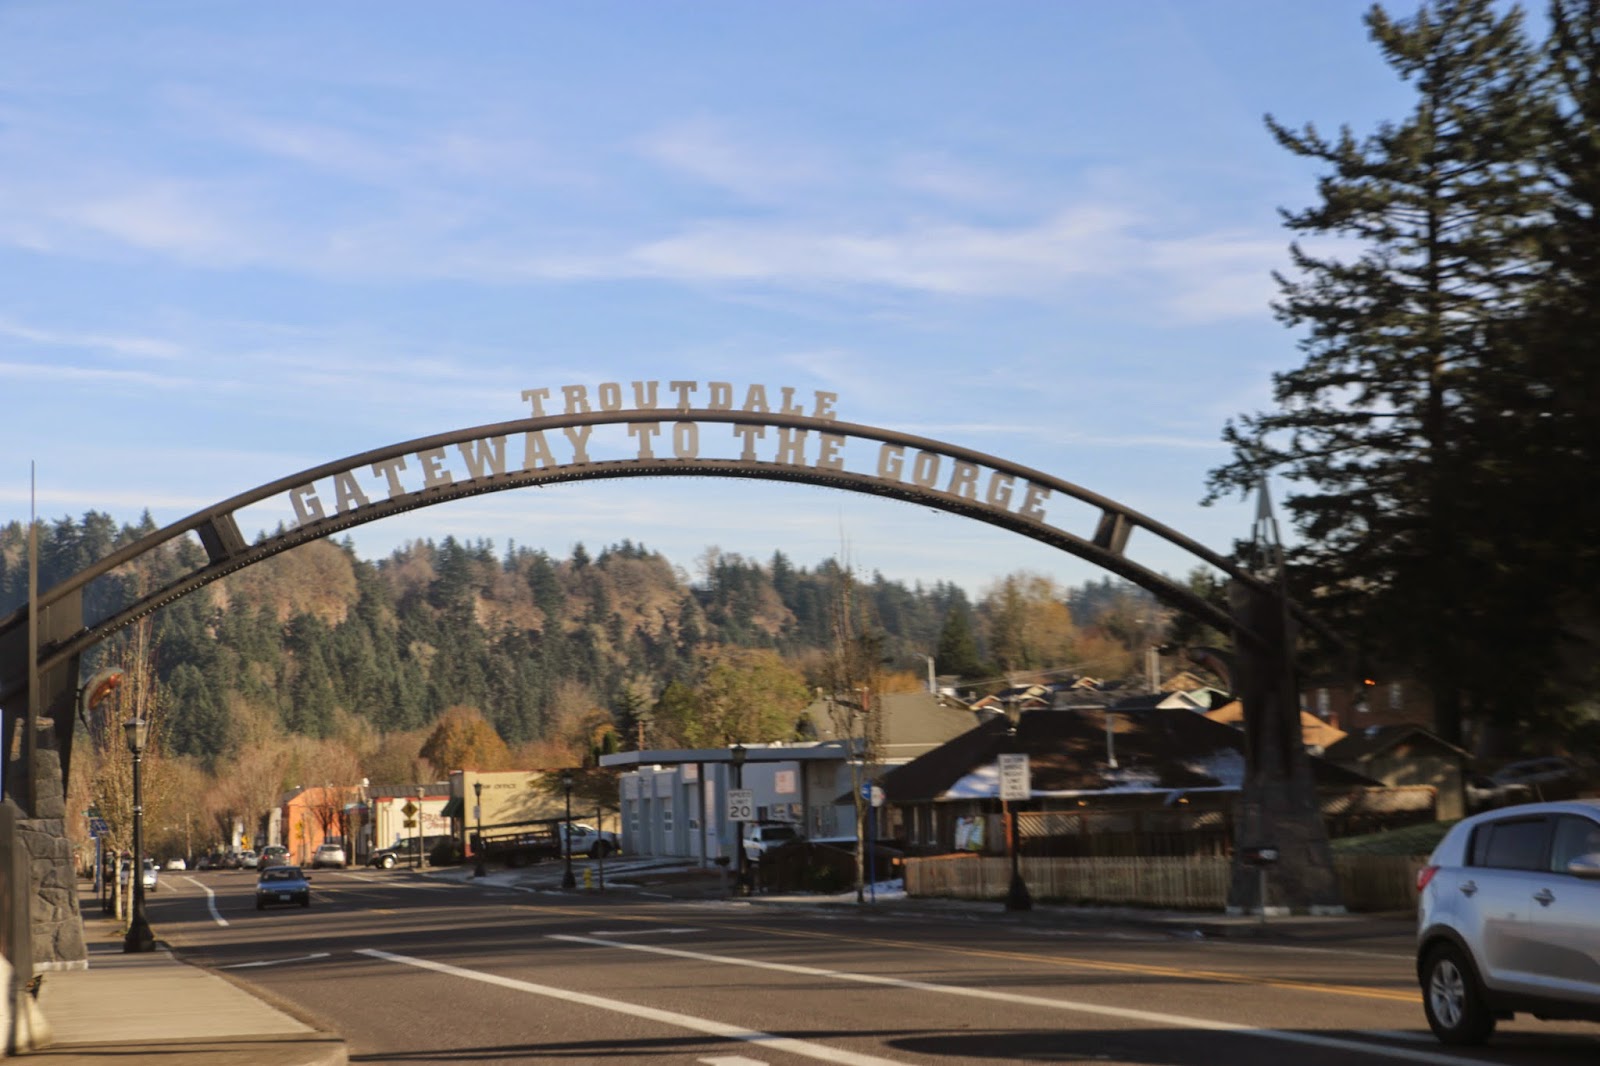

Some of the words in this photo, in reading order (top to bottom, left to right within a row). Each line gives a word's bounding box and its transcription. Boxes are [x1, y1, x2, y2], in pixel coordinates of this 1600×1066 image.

[521, 381, 839, 421] TROUTDALE
[288, 425, 592, 526] GATEWAY
[628, 420, 699, 460] TO
[733, 423, 846, 471] THE
[877, 442, 1052, 524] GORGE
[729, 805, 751, 818] 20
